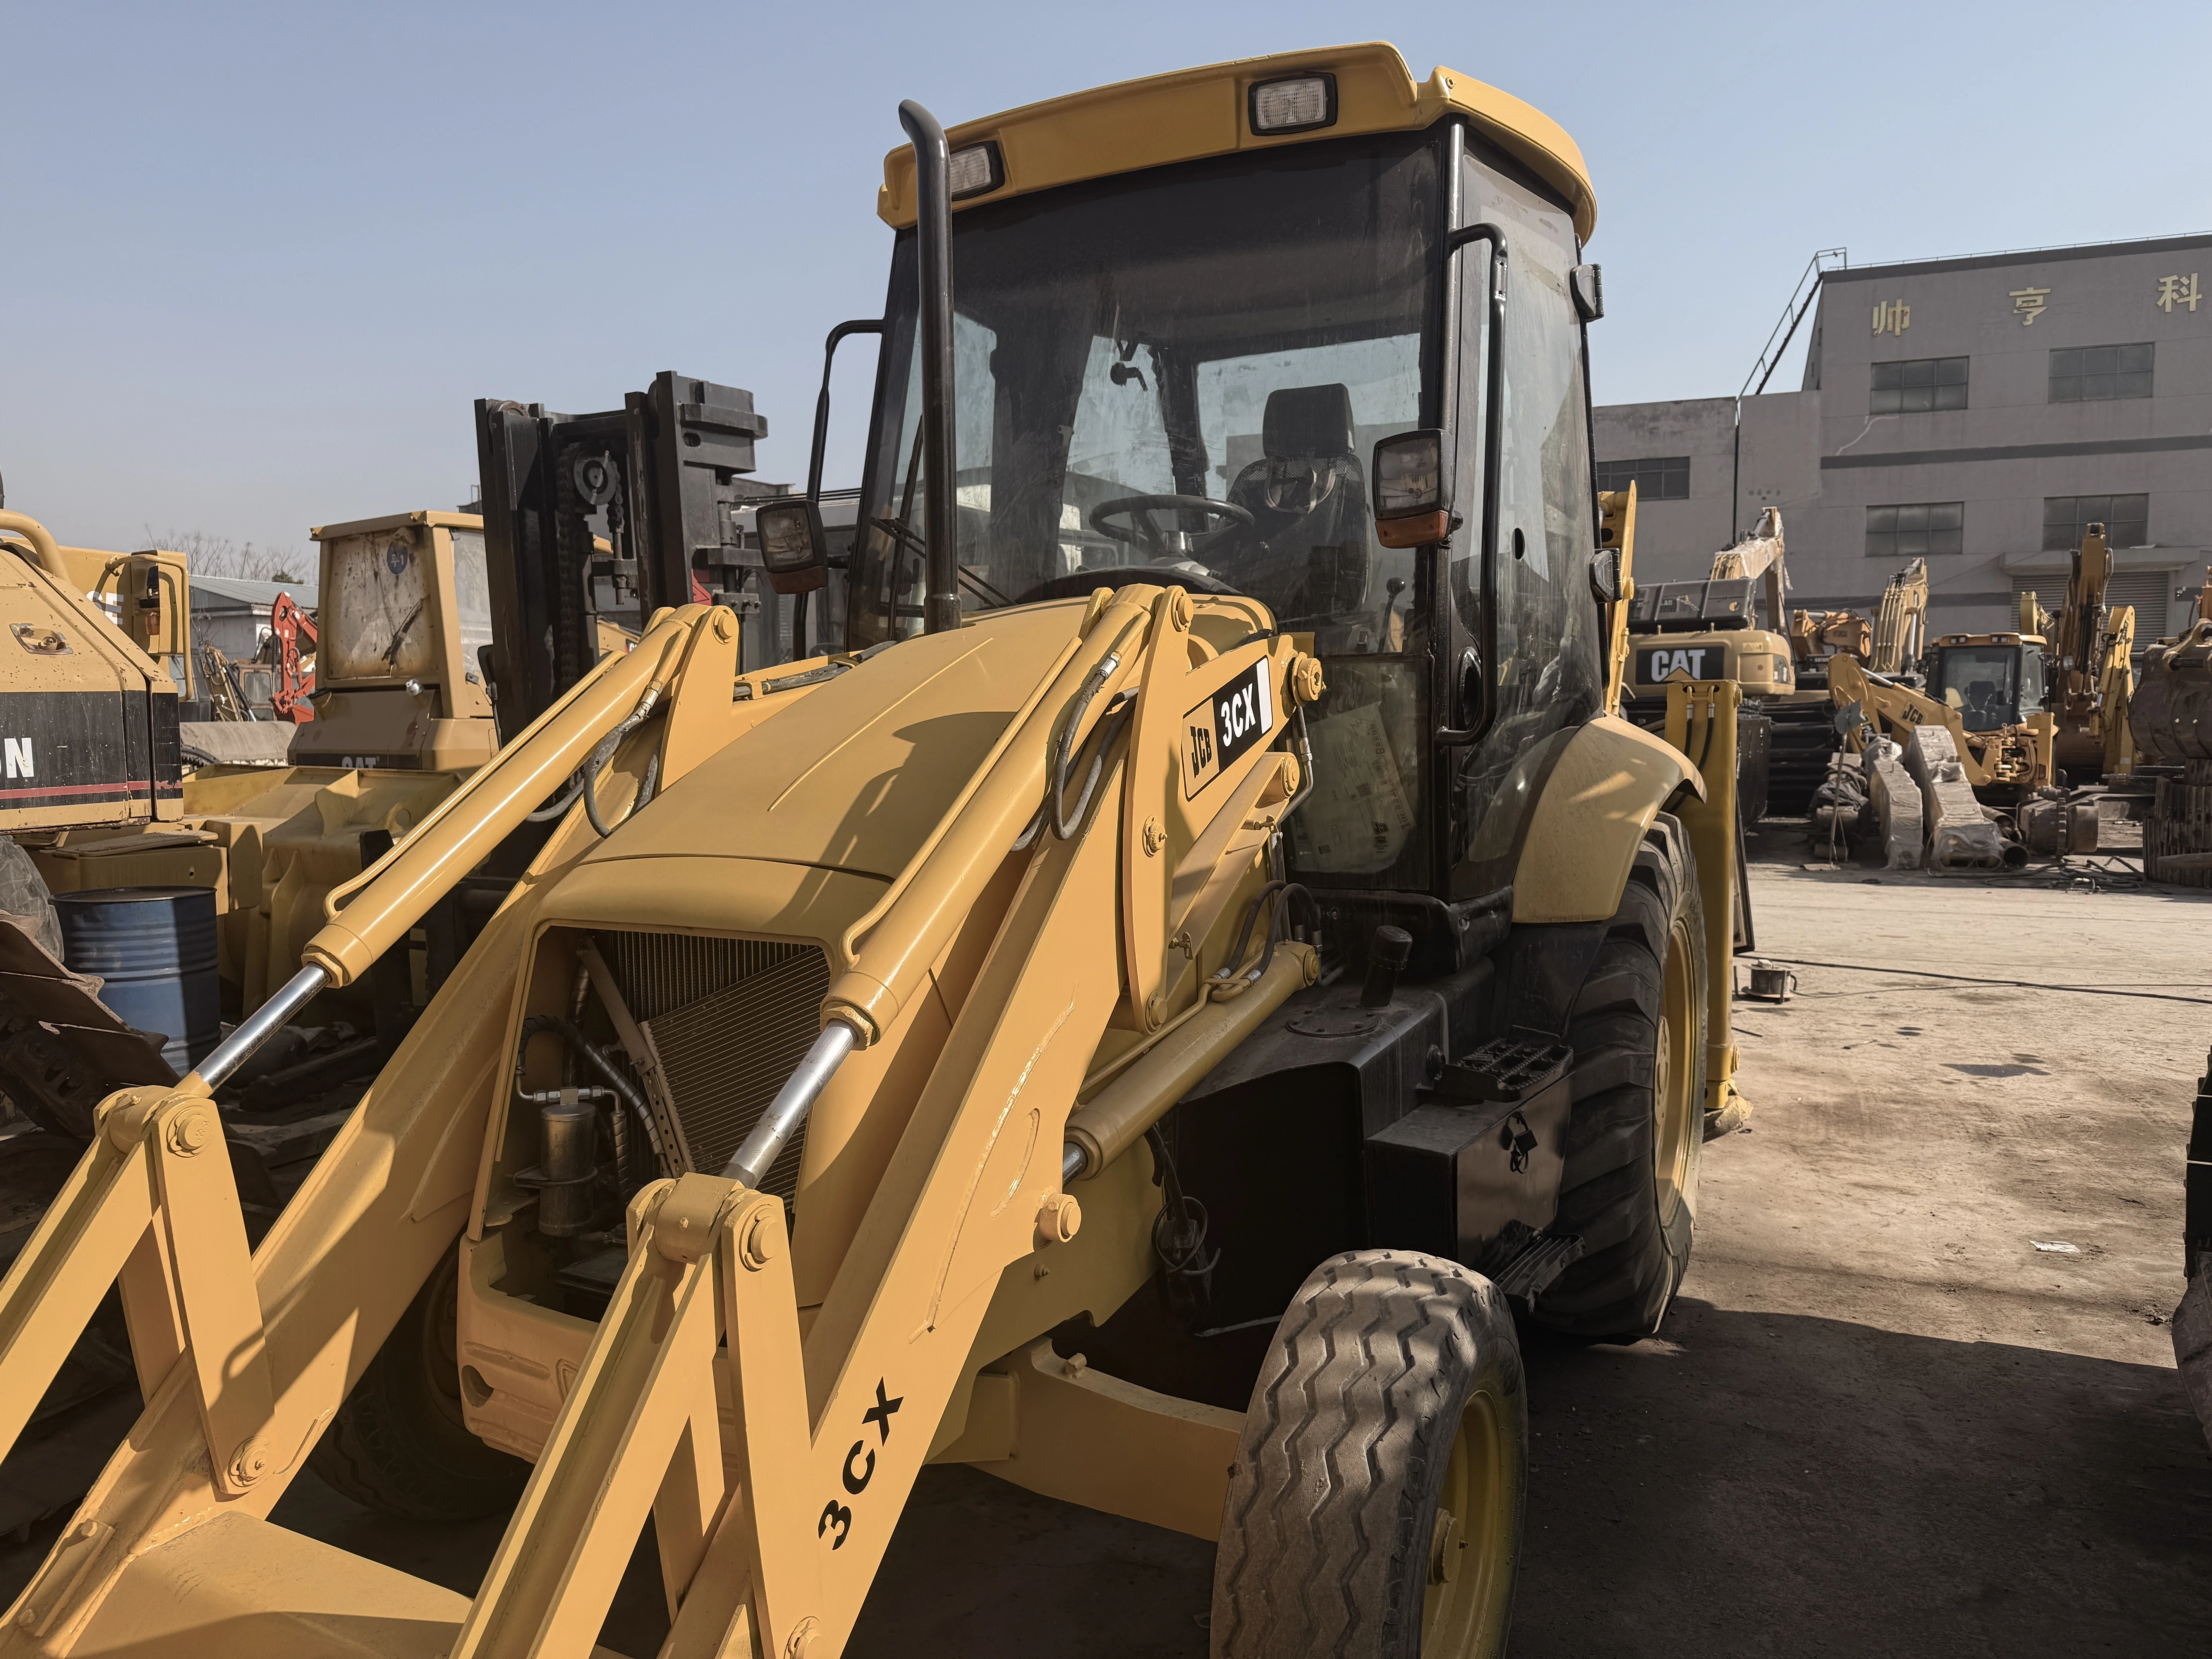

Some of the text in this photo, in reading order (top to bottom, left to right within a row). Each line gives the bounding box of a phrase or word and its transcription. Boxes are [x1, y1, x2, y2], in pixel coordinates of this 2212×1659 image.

[1652, 649, 1705, 682] CAT
[1221, 683, 1255, 747] 3CX
[1902, 703, 1923, 725] JCB
[0, 737, 34, 778] N
[1190, 726, 1212, 778] JCB
[818, 1376, 904, 1551] 3CX
